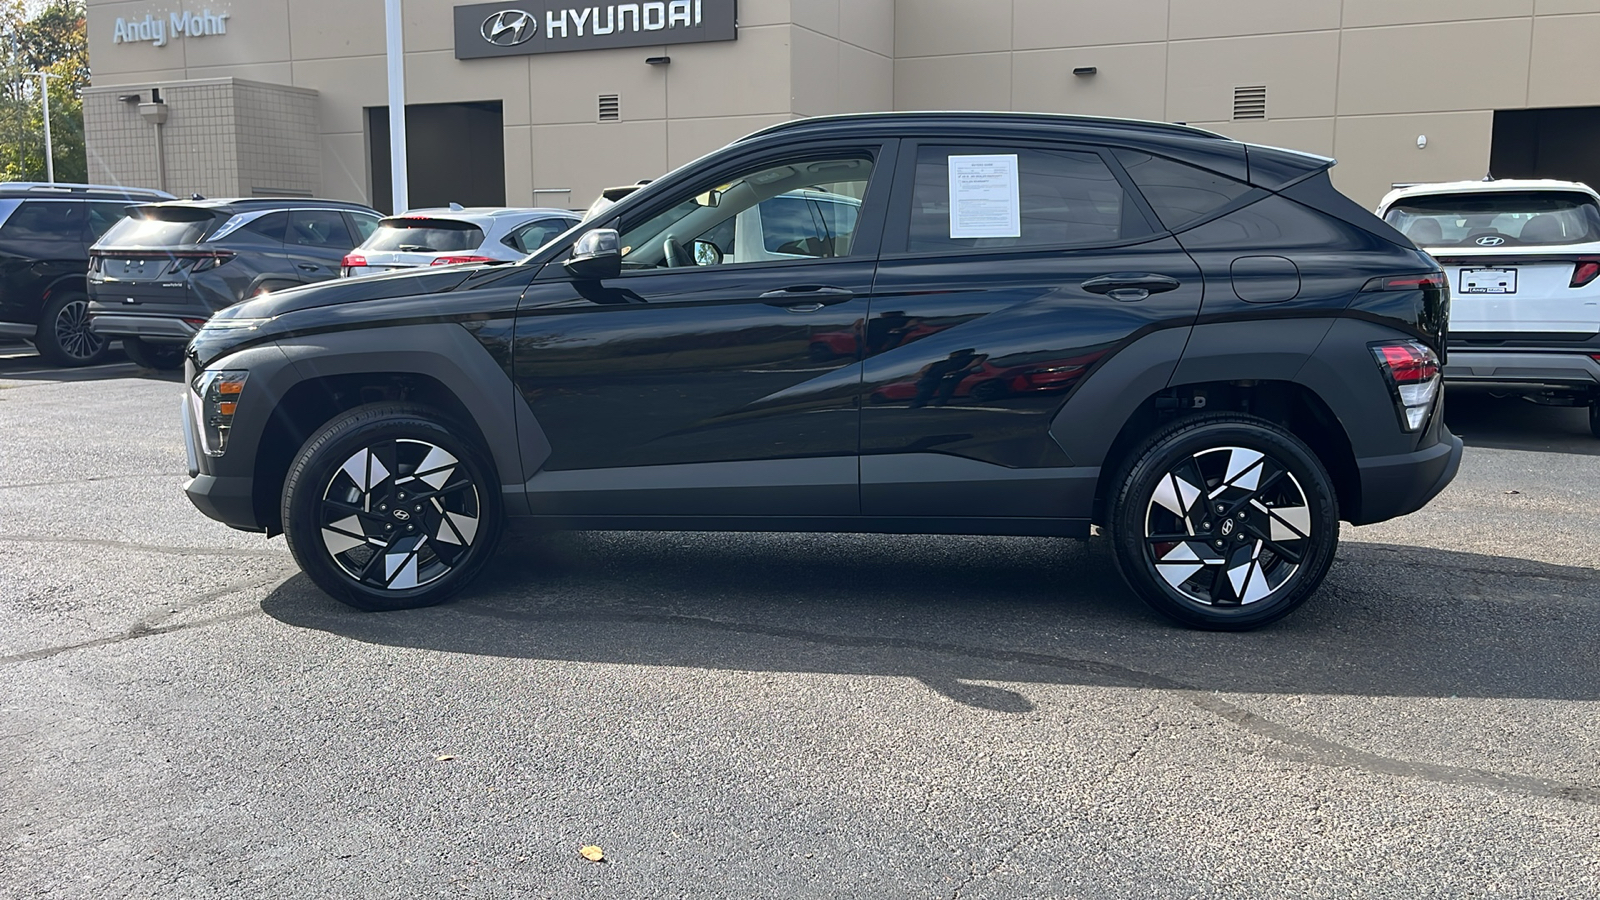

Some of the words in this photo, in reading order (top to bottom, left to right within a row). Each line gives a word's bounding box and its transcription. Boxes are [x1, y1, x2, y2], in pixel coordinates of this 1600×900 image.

[113, 14, 167, 47] Andy
[170, 8, 230, 38] Mohr
[546, 0, 702, 39] HYUNDAI
